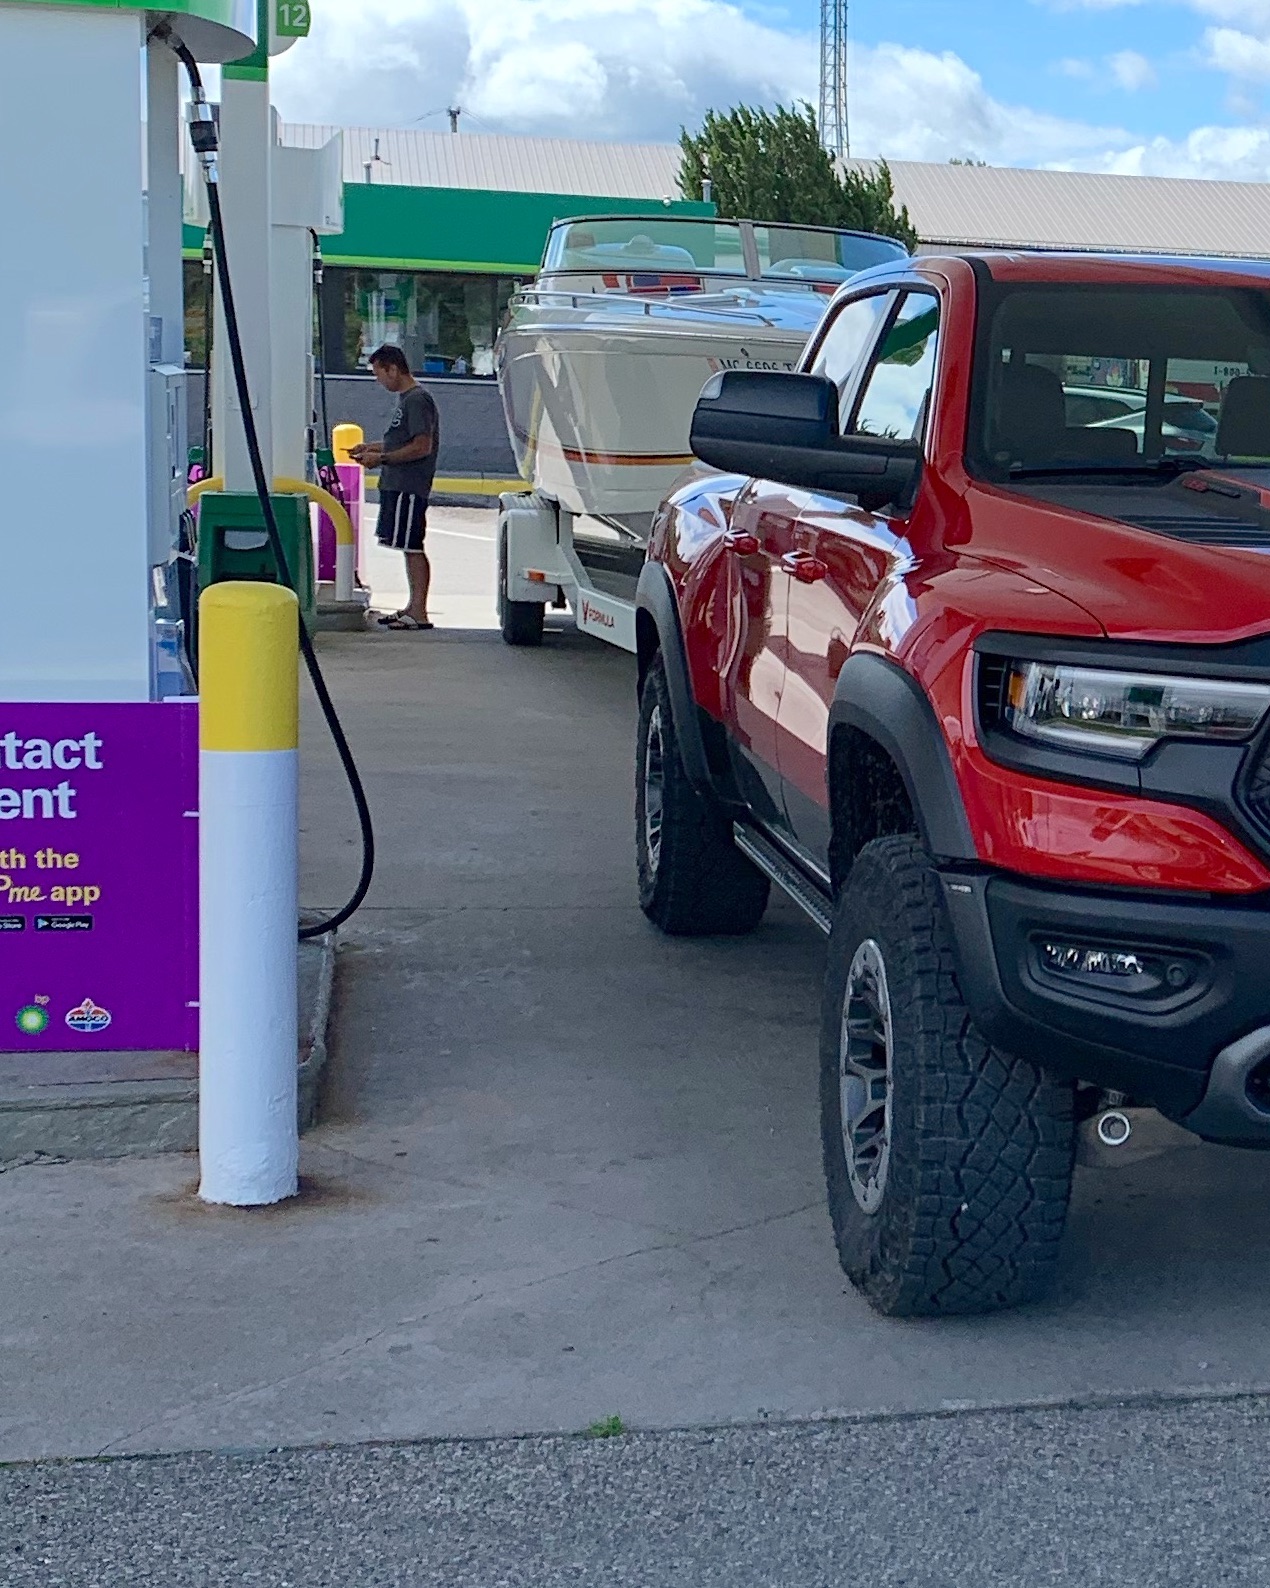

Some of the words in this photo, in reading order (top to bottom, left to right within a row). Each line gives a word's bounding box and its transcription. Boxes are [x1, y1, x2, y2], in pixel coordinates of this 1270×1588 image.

[279, 4, 307, 27] 12
[34, 847, 80, 869] the
[50, 885, 101, 907] app
